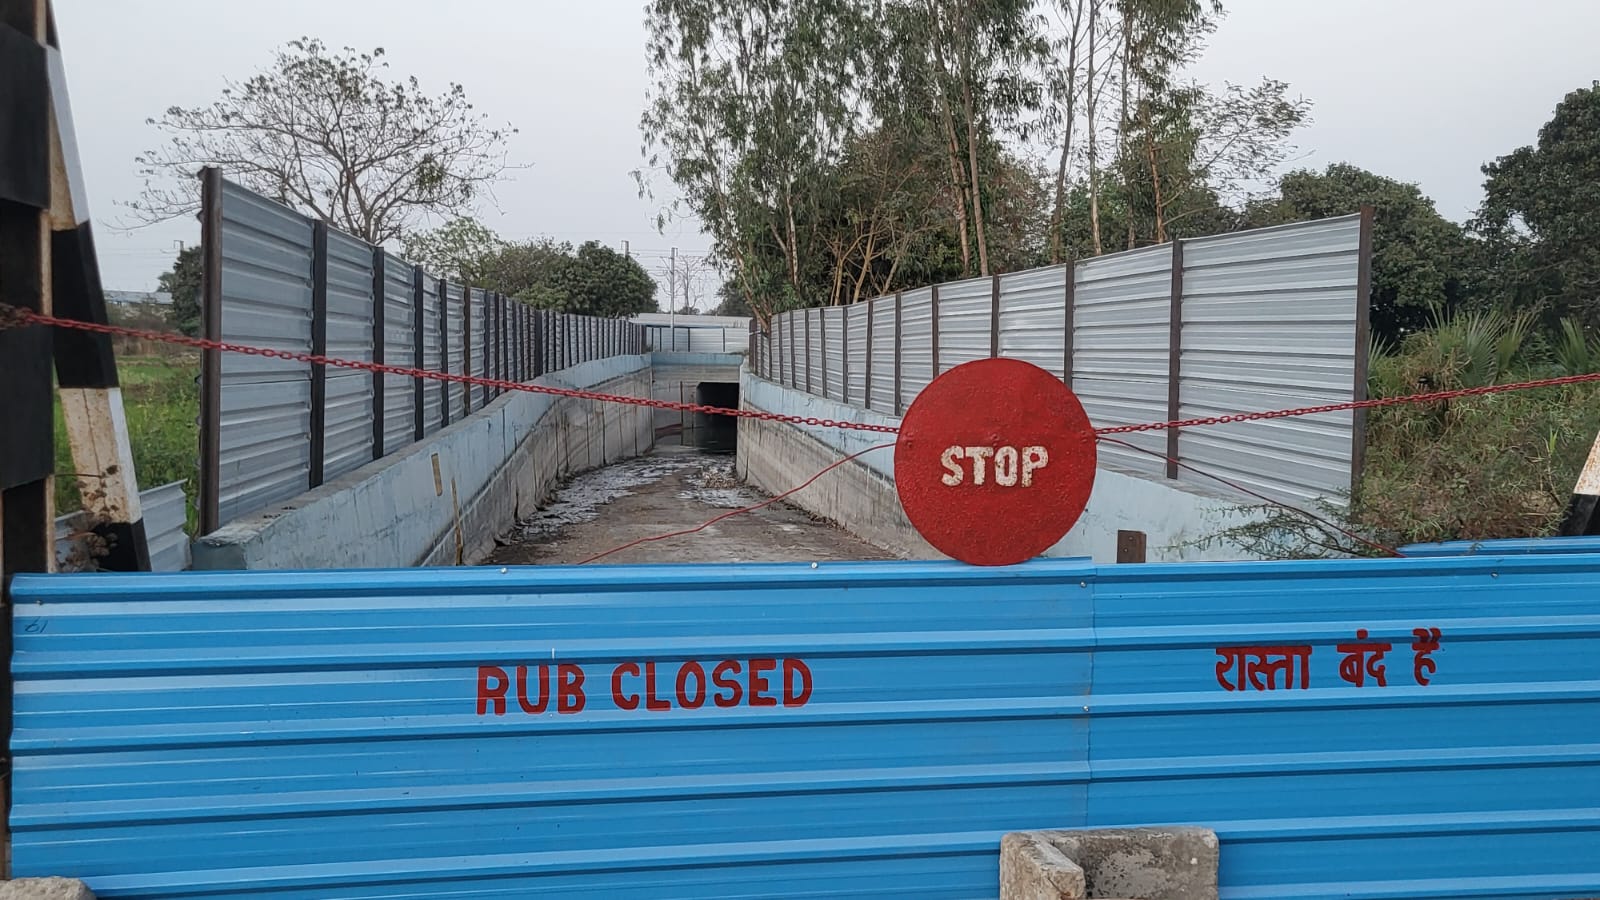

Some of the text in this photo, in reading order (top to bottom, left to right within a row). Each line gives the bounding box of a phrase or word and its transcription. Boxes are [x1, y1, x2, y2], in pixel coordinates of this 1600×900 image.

[940, 445, 1049, 488] STOP
[476, 658, 813, 716] RUB CLOSED
[1215, 627, 1441, 691] रास्ता बंद है
